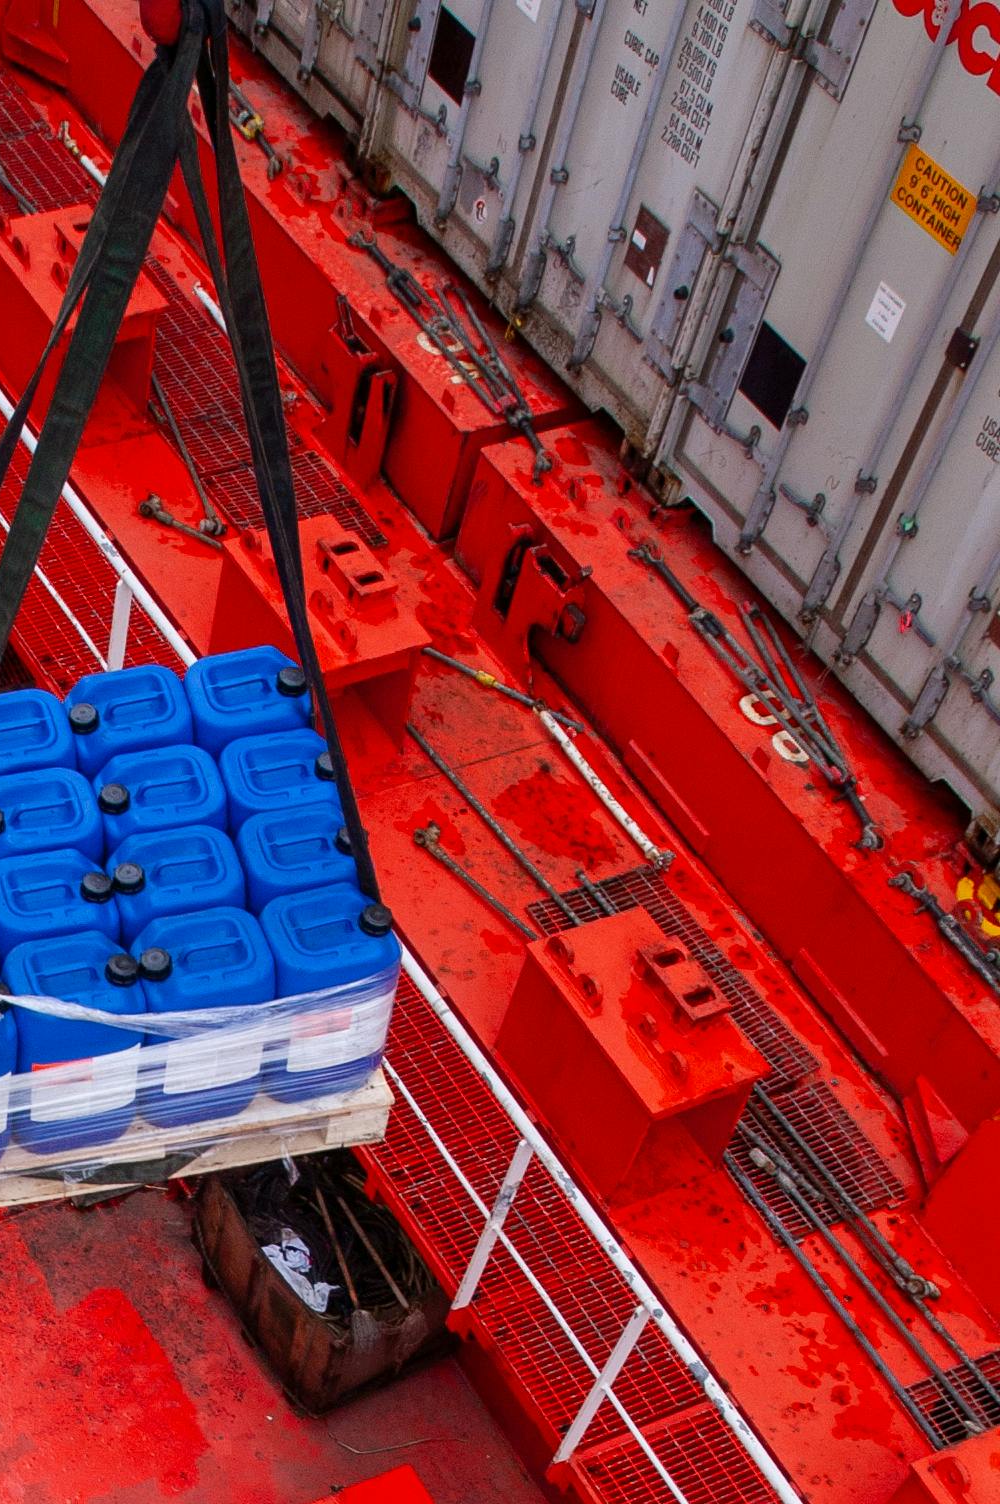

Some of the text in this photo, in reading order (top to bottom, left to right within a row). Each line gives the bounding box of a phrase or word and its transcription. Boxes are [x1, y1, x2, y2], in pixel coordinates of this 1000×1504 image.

[712, 38, 724, 58] LB
[611, 80, 630, 105] CUBE
[614, 64, 642, 97] USABLE
[701, 76, 713, 94] LB
[915, 157, 968, 210] CAUTION
[897, 186, 962, 252] CONTAINER
[931, 194, 962, 227] HIGH
